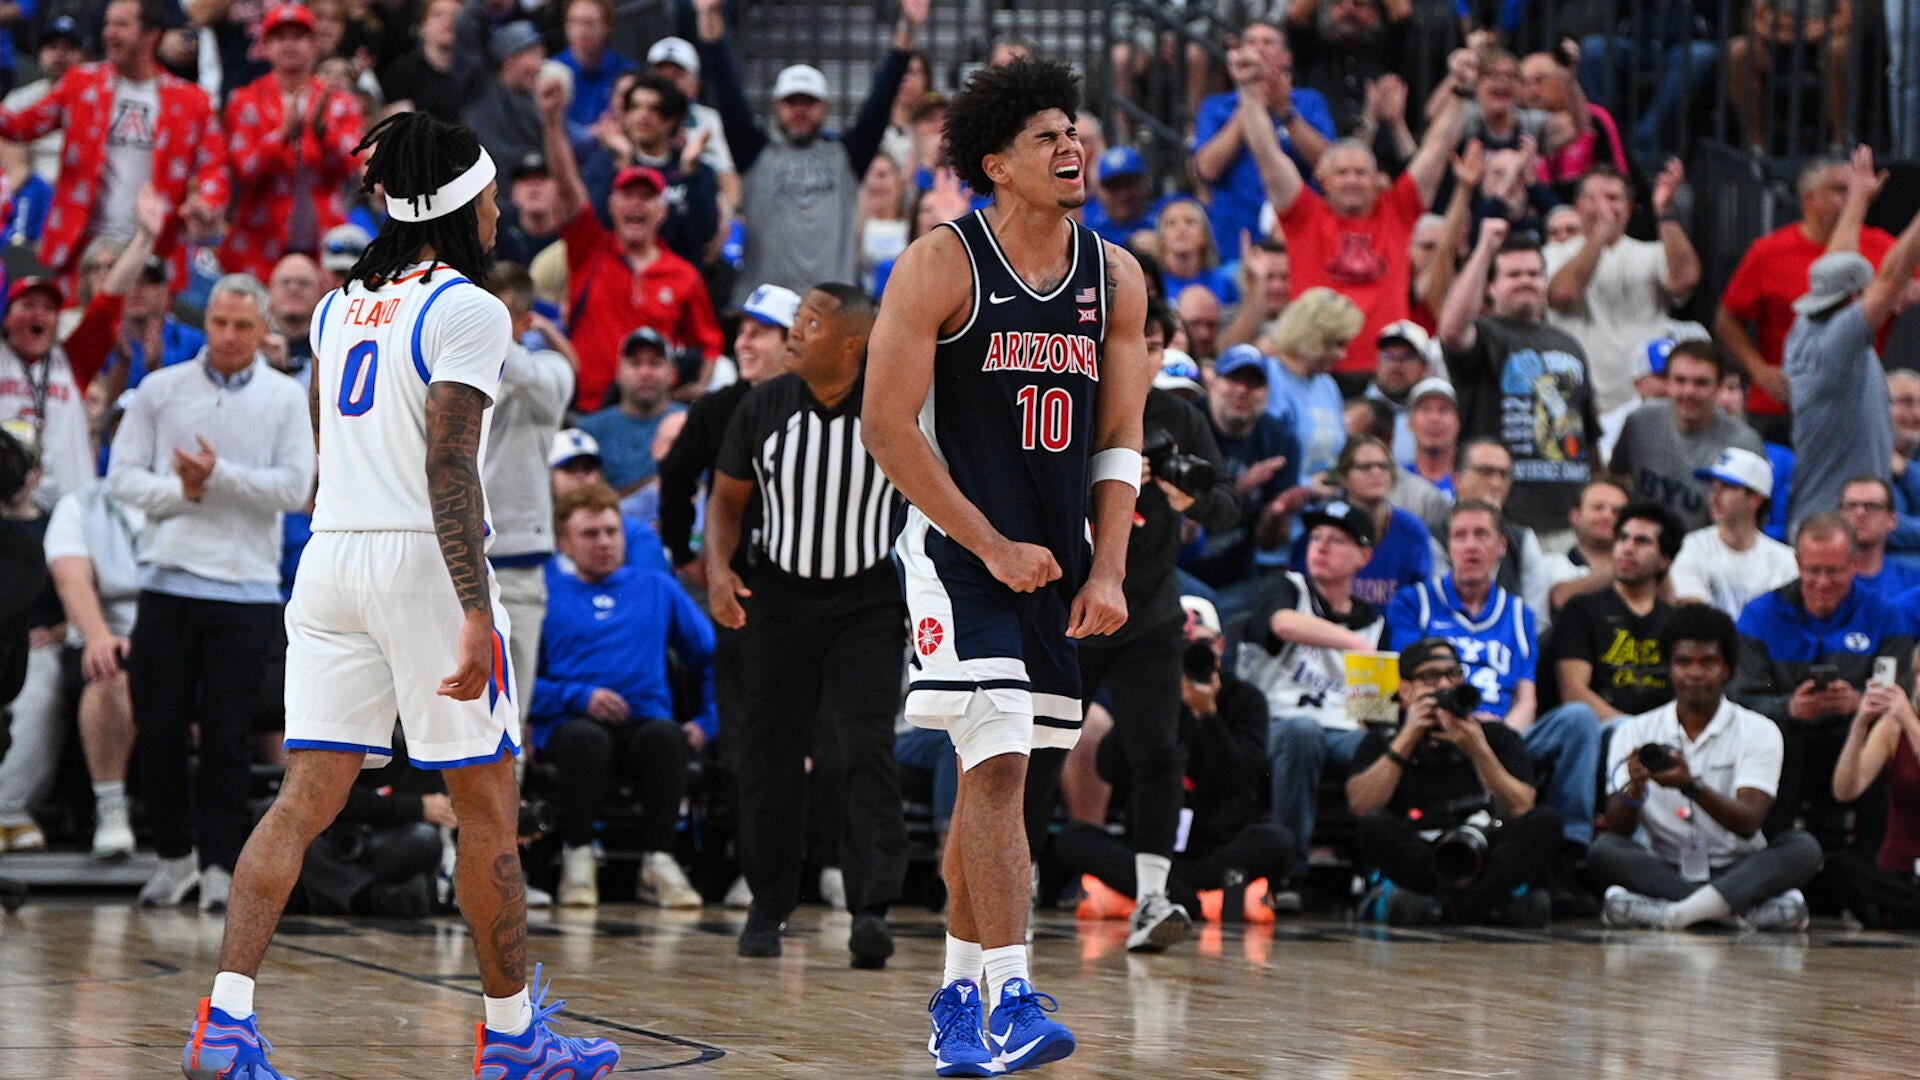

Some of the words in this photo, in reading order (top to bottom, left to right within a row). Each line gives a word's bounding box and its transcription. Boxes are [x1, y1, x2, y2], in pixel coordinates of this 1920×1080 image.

[337, 339, 379, 416] 0
[981, 331, 1099, 382] ARIZONA
[1016, 384, 1073, 452] 10
